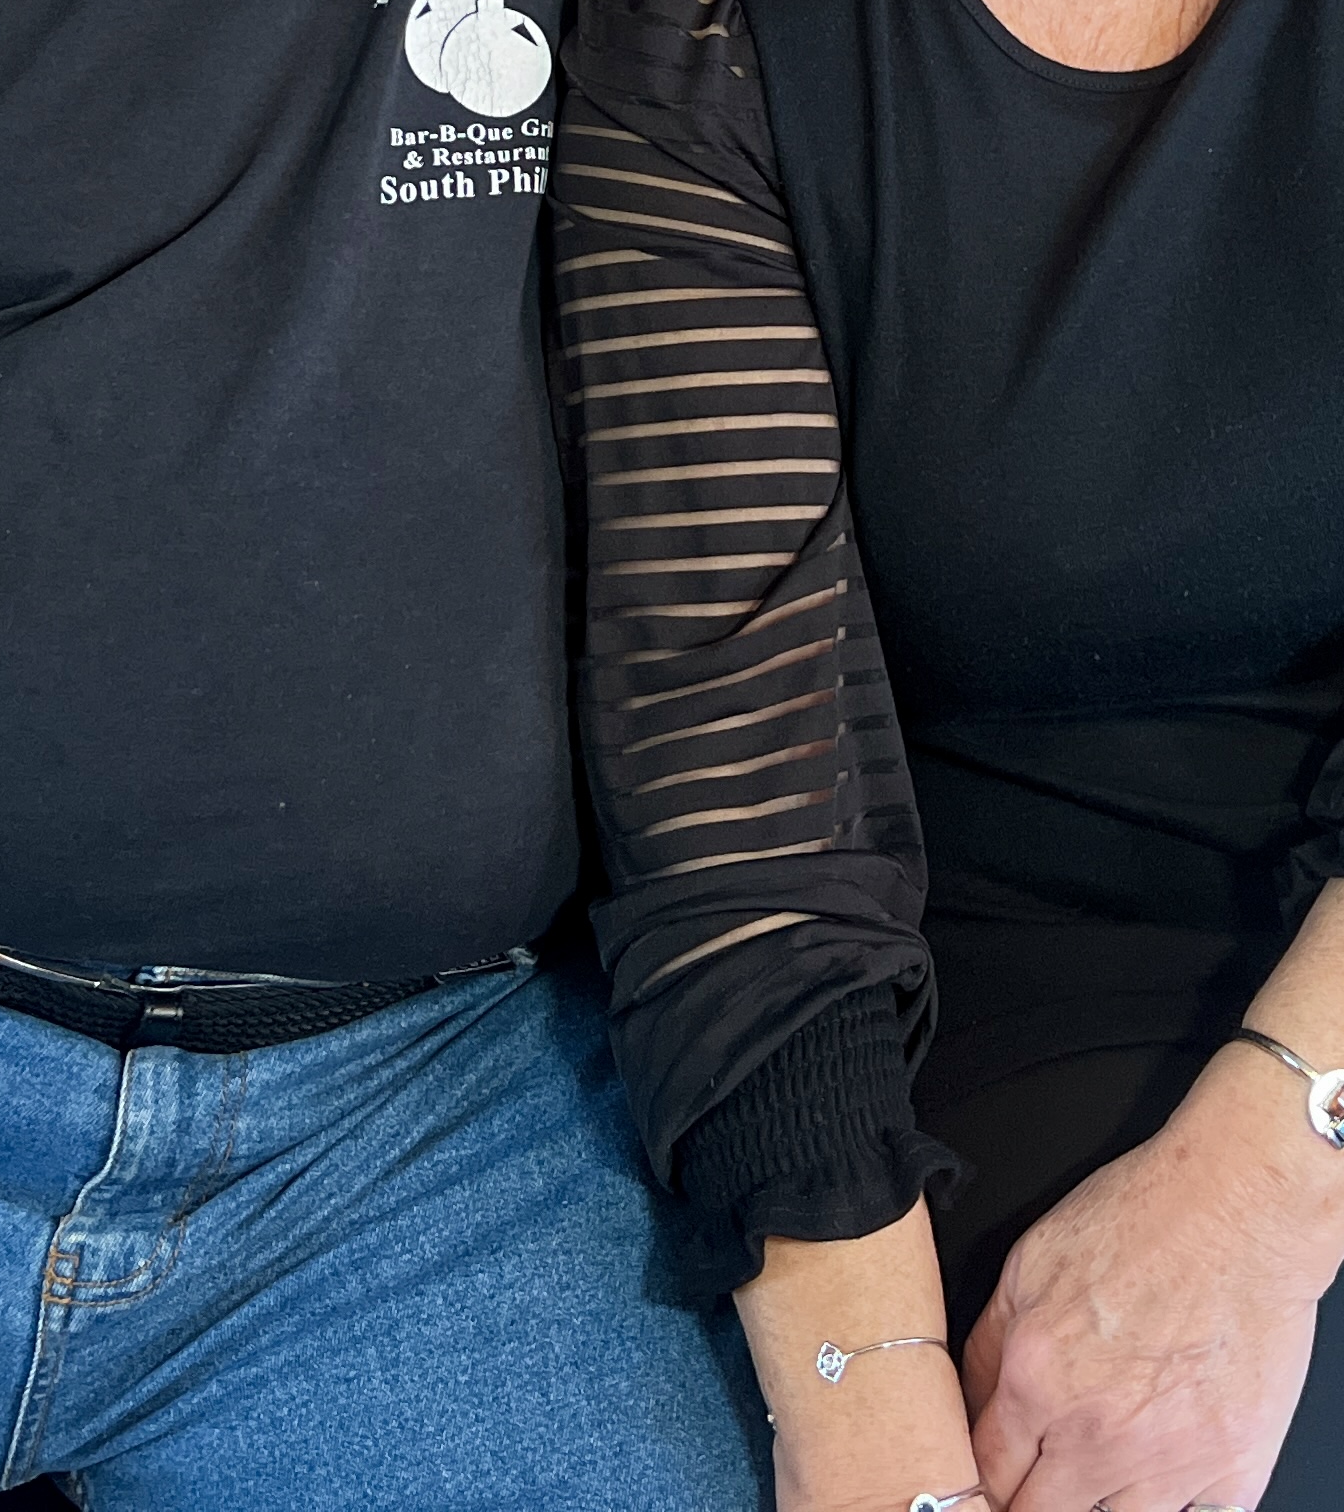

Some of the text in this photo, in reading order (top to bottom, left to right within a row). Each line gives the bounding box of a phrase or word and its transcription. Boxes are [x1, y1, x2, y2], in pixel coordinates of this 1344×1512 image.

[390, 123, 514, 147] Bar-B-Que
[402, 150, 425, 170] &
[380, 171, 476, 205] South
